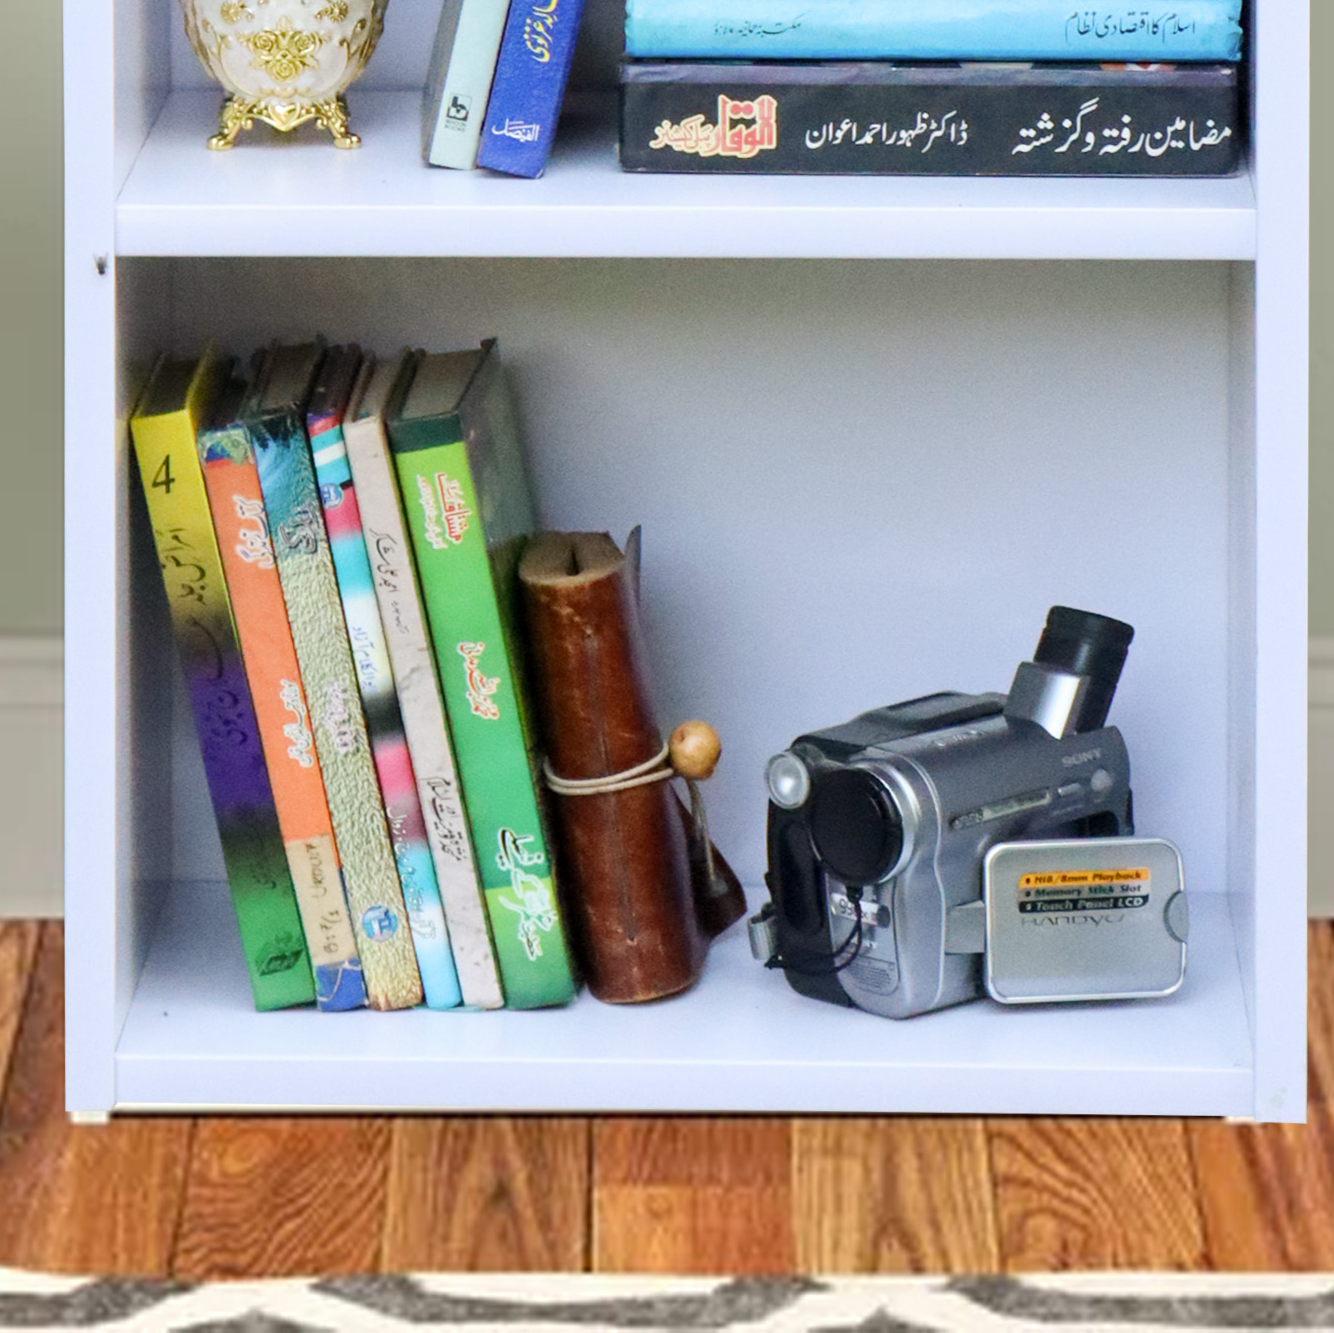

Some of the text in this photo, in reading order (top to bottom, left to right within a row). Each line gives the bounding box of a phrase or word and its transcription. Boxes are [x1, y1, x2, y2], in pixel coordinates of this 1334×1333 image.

[516, 16, 557, 64] غزنوی
[1064, 11, 1098, 43] نظام
[1095, 11, 1151, 39] اقتصادی
[1162, 12, 1196, 43] اسلام
[804, 110, 968, 154] ڈاکٹر ظہور احمد اعوان
[1011, 96, 1100, 156] گزشتہ
[1098, 114, 1144, 156] رفتہ
[1144, 115, 1232, 157] مضامین
[151, 455, 176, 494] 4
[367, 522, 401, 567] شاکر
[376, 576, 400, 596] امجد
[1061, 747, 1102, 769] SONY
[1034, 884, 1143, 898] Memory Stick Slot
[1092, 871, 1142, 882] Playback
[1036, 897, 1144, 912] Touch Panel LCD
